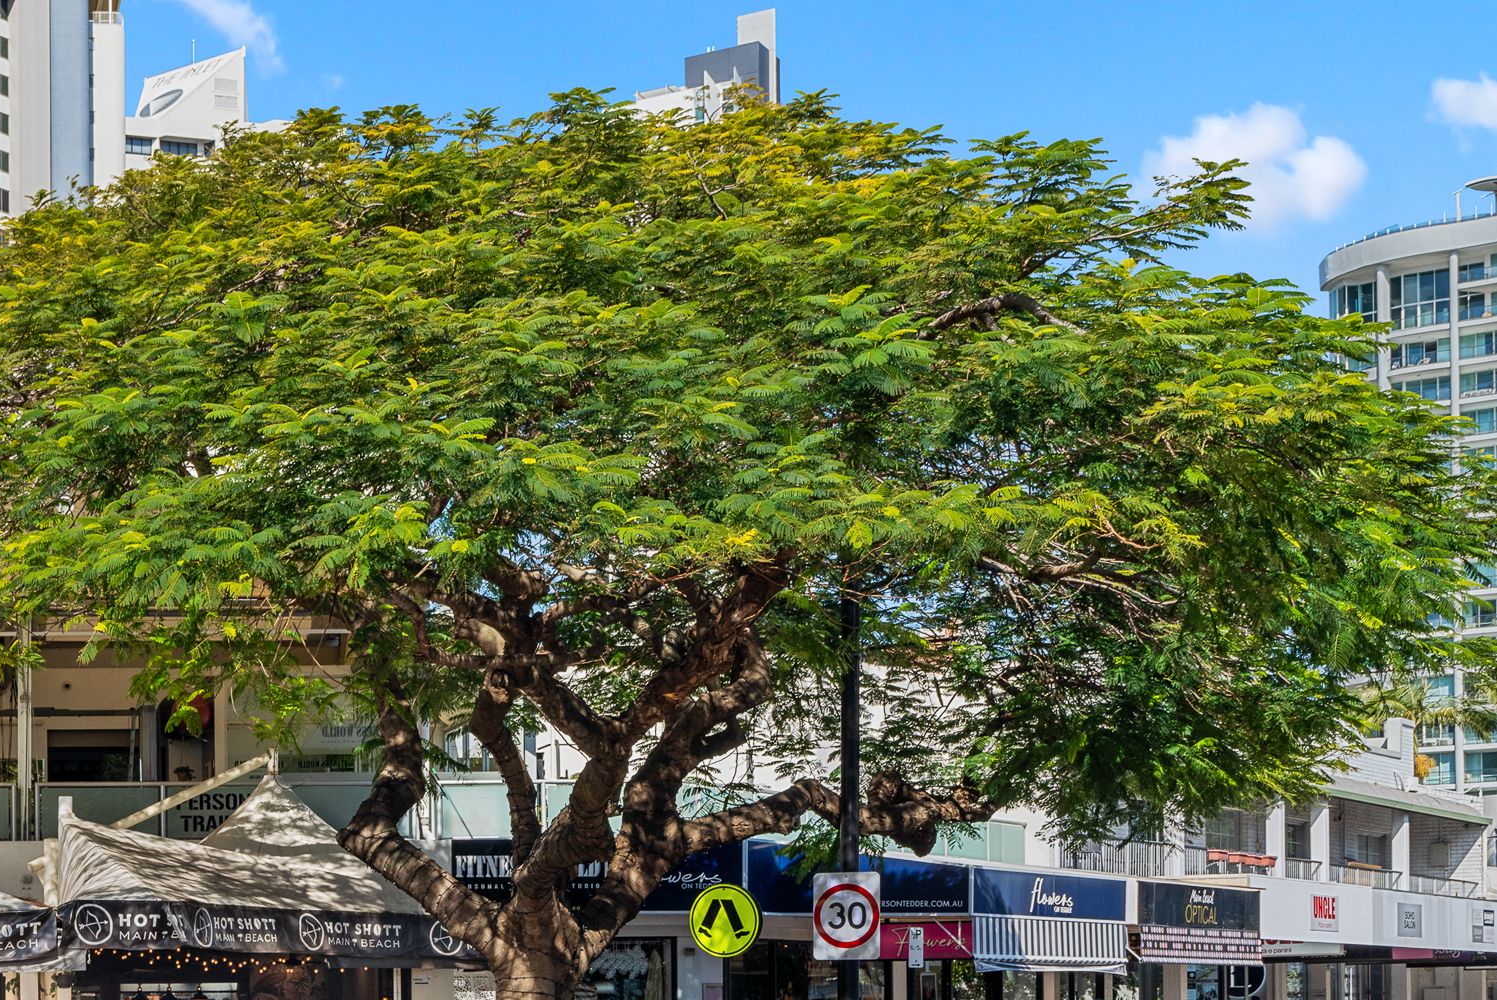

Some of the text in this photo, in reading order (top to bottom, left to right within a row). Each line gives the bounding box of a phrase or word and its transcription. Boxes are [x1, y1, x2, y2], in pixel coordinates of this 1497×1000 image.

[455, 855, 513, 878] FITNE
[118, 913, 161, 927] HOT
[827, 901, 867, 930] 30
[1185, 904, 1218, 925] OPTICAL
[214, 916, 277, 931] HOT SHOTT
[325, 921, 402, 937] HOT SHOTT
[120, 931, 158, 941] MAIN
[215, 932, 278, 943] MAIN BEACH
[328, 937, 401, 948] MAIN BEACH
